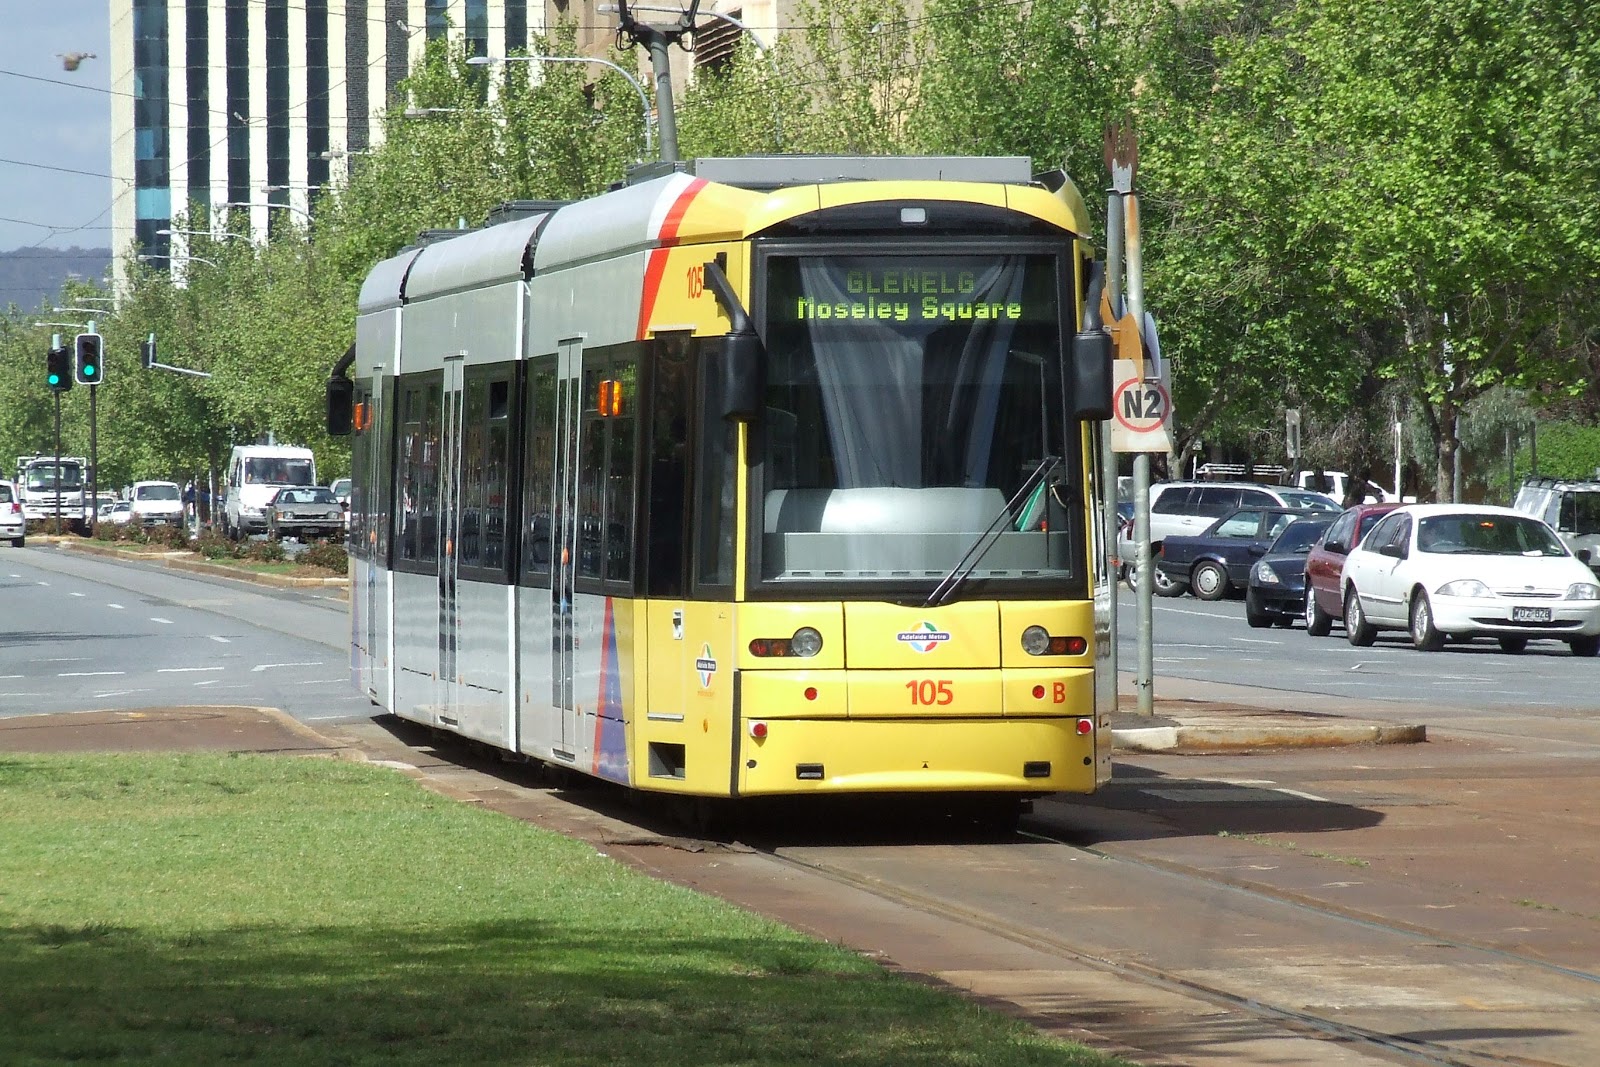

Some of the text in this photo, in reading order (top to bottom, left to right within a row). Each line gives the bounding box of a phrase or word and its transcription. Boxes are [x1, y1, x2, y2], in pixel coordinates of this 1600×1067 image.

[687, 266, 703, 299] 105
[847, 271, 974, 294] GLENELG
[797, 297, 1022, 321] Moseley Square
[1124, 390, 1161, 418] N2
[906, 679, 953, 706] 105
[1053, 682, 1066, 704] B
